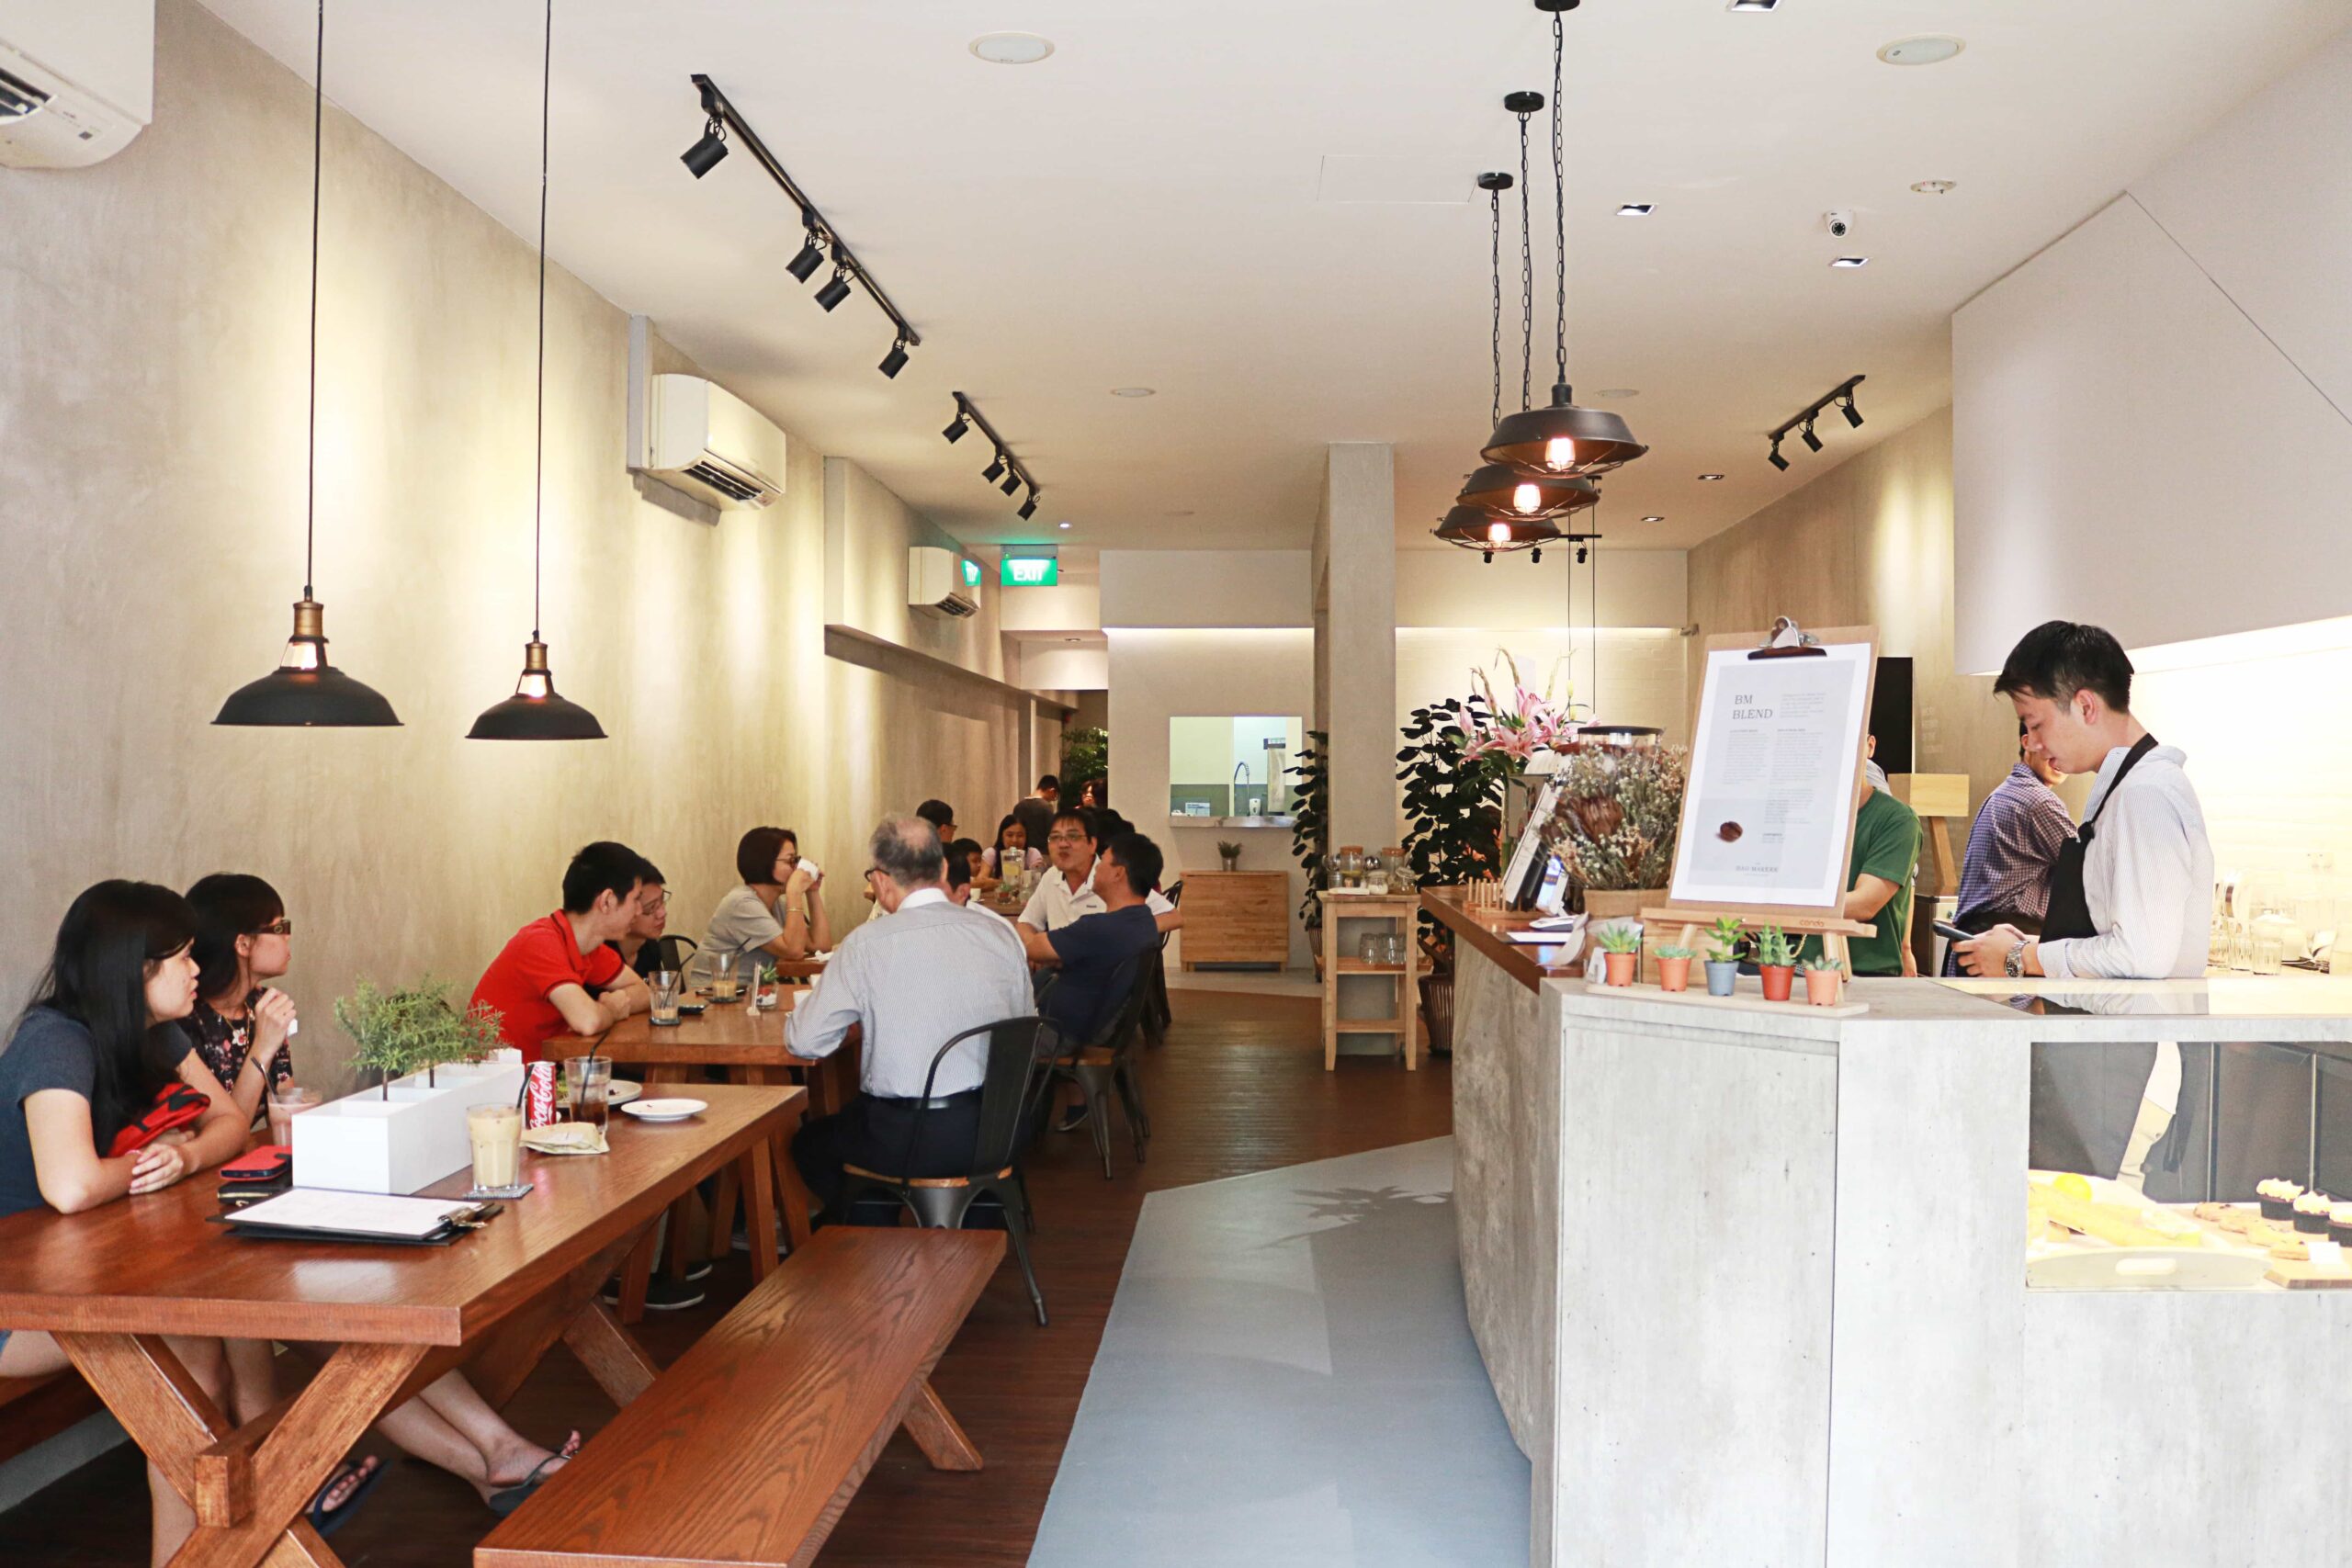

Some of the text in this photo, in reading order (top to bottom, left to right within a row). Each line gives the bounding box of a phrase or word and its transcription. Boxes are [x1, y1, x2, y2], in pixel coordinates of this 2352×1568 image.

[1013, 567, 1044, 581] EXIT
[1735, 694, 1753, 705] BM
[1733, 709, 1773, 719] BLEND
